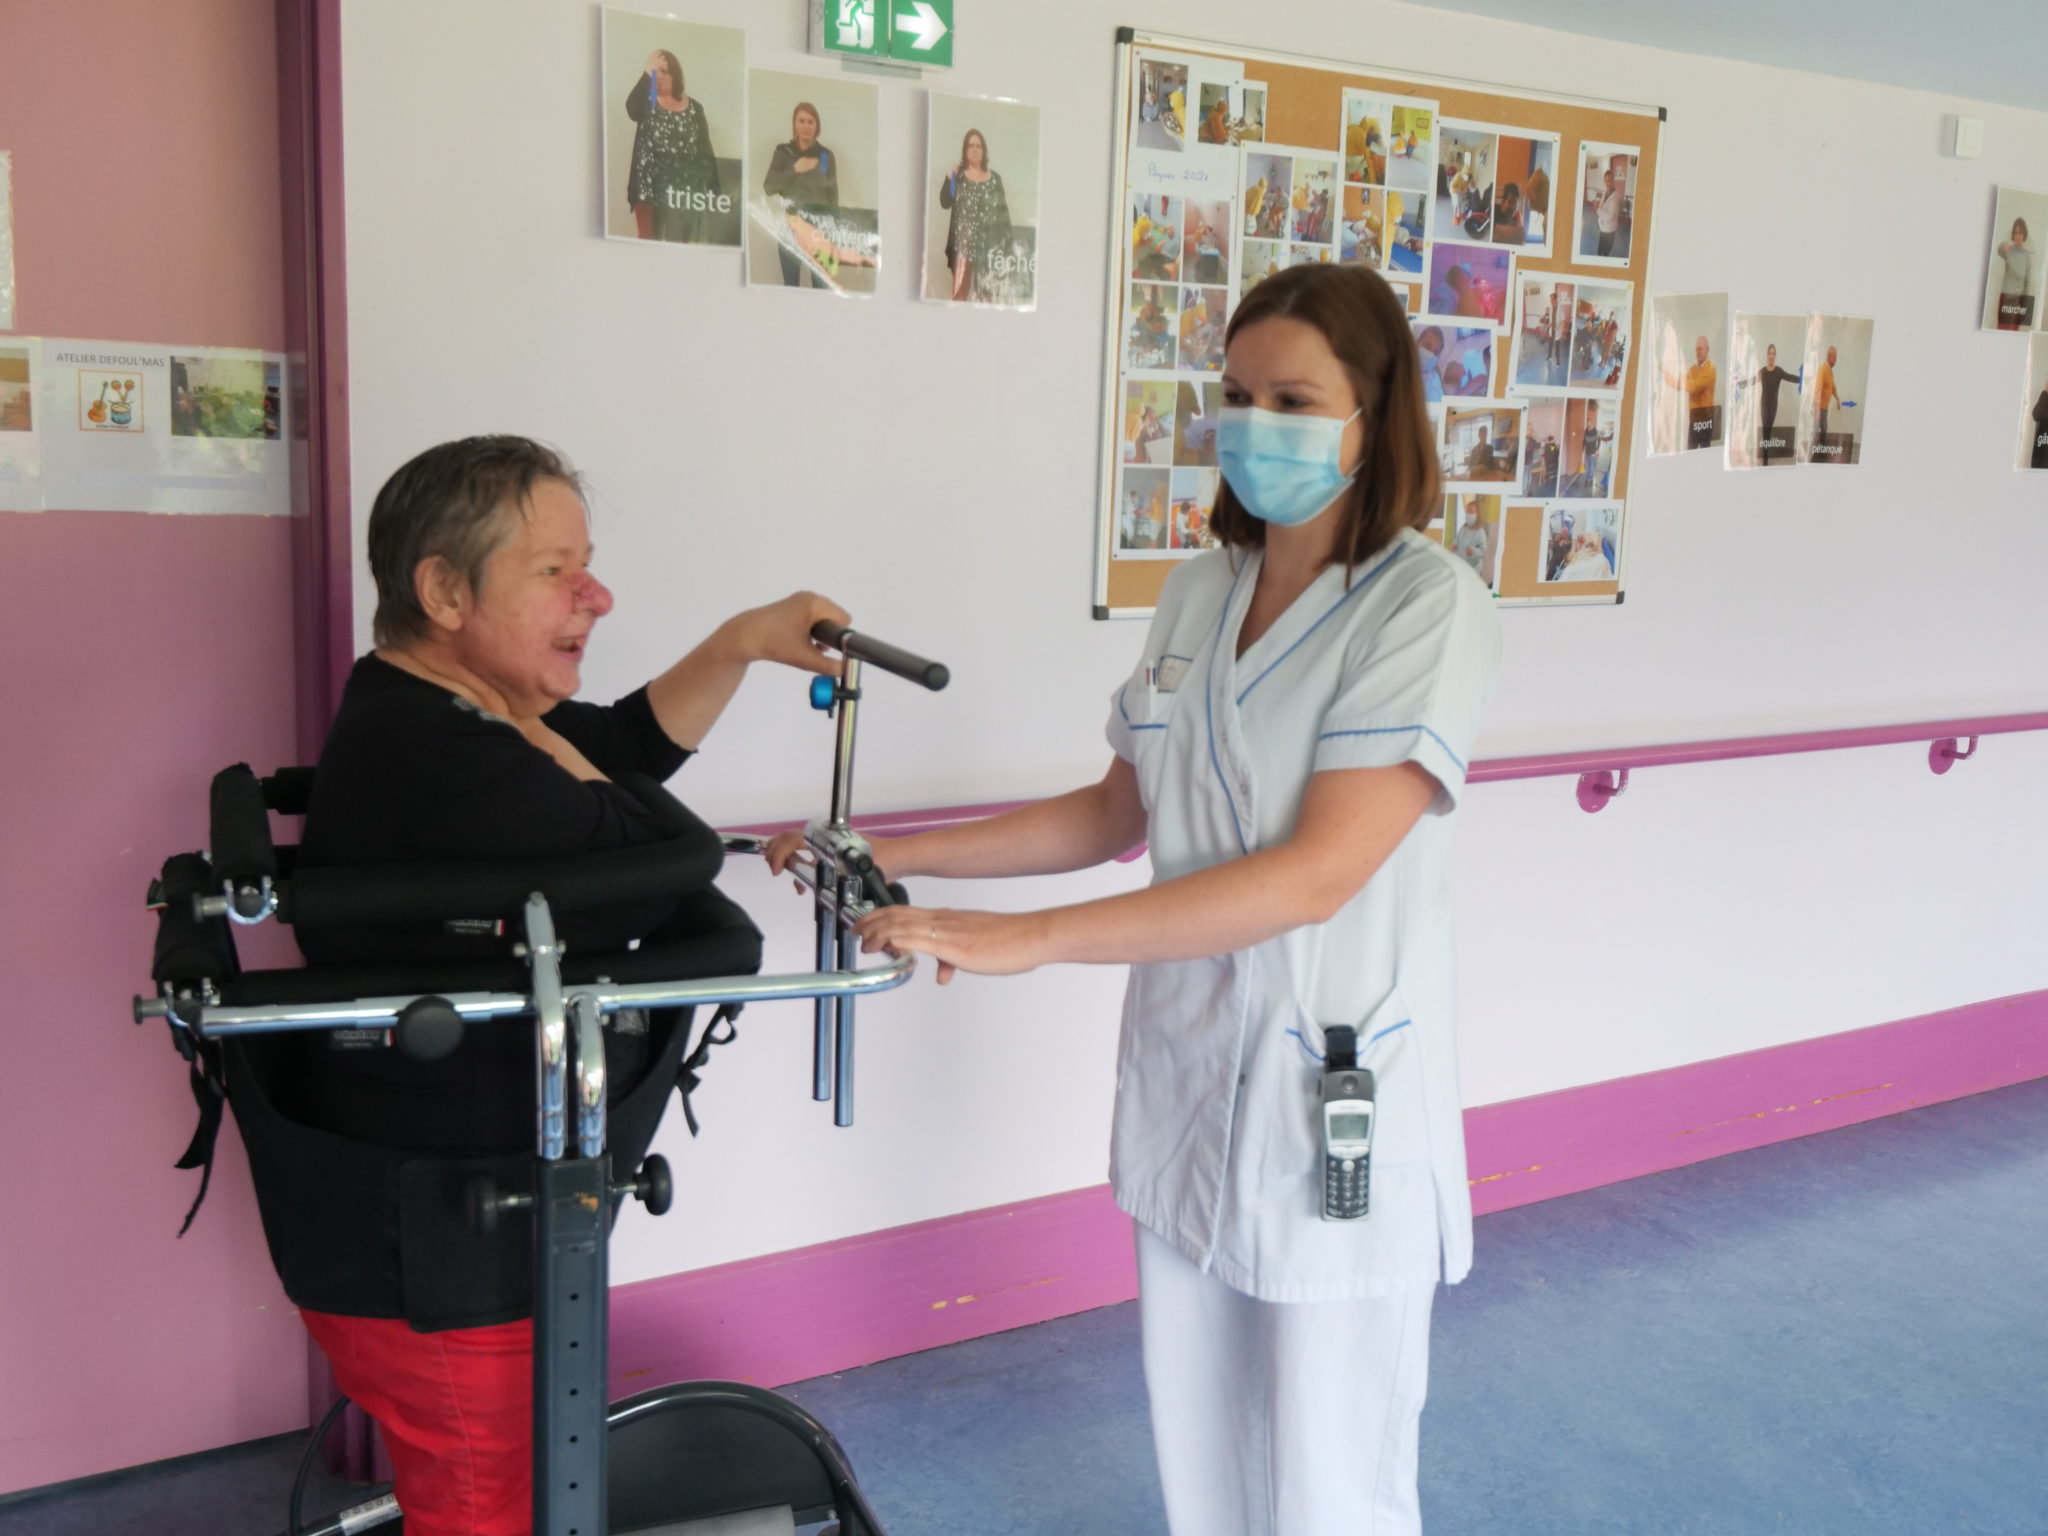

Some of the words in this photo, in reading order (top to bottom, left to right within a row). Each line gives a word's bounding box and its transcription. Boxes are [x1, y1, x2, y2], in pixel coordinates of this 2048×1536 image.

[665, 185, 732, 213] triste
[56, 352, 97, 364] ATELIER
[100, 355, 165, 367] DEFOUL'MAS
[1693, 419, 1713, 432] sport
